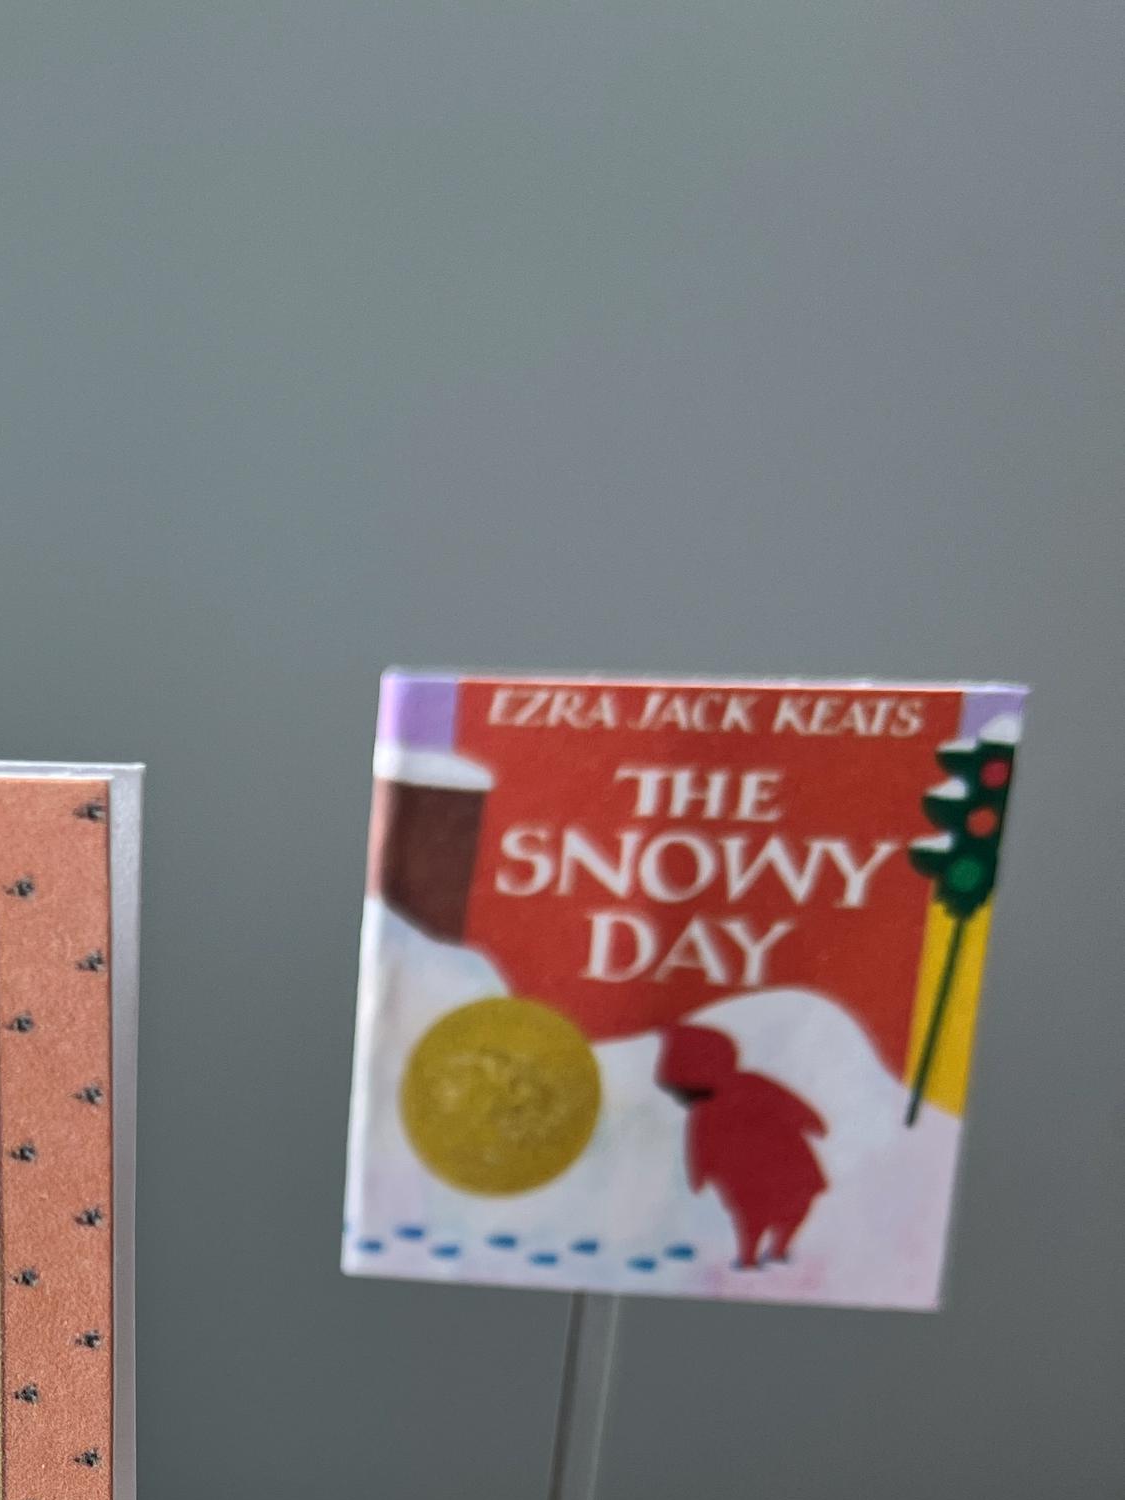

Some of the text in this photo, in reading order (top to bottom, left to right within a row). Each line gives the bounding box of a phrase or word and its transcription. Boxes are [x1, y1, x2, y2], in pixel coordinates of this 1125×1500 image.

[486, 687, 926, 737] EZRA JACK KEATS
[614, 764, 785, 823] THE
[493, 826, 901, 909] SNOWY
[581, 909, 797, 988] DAY
